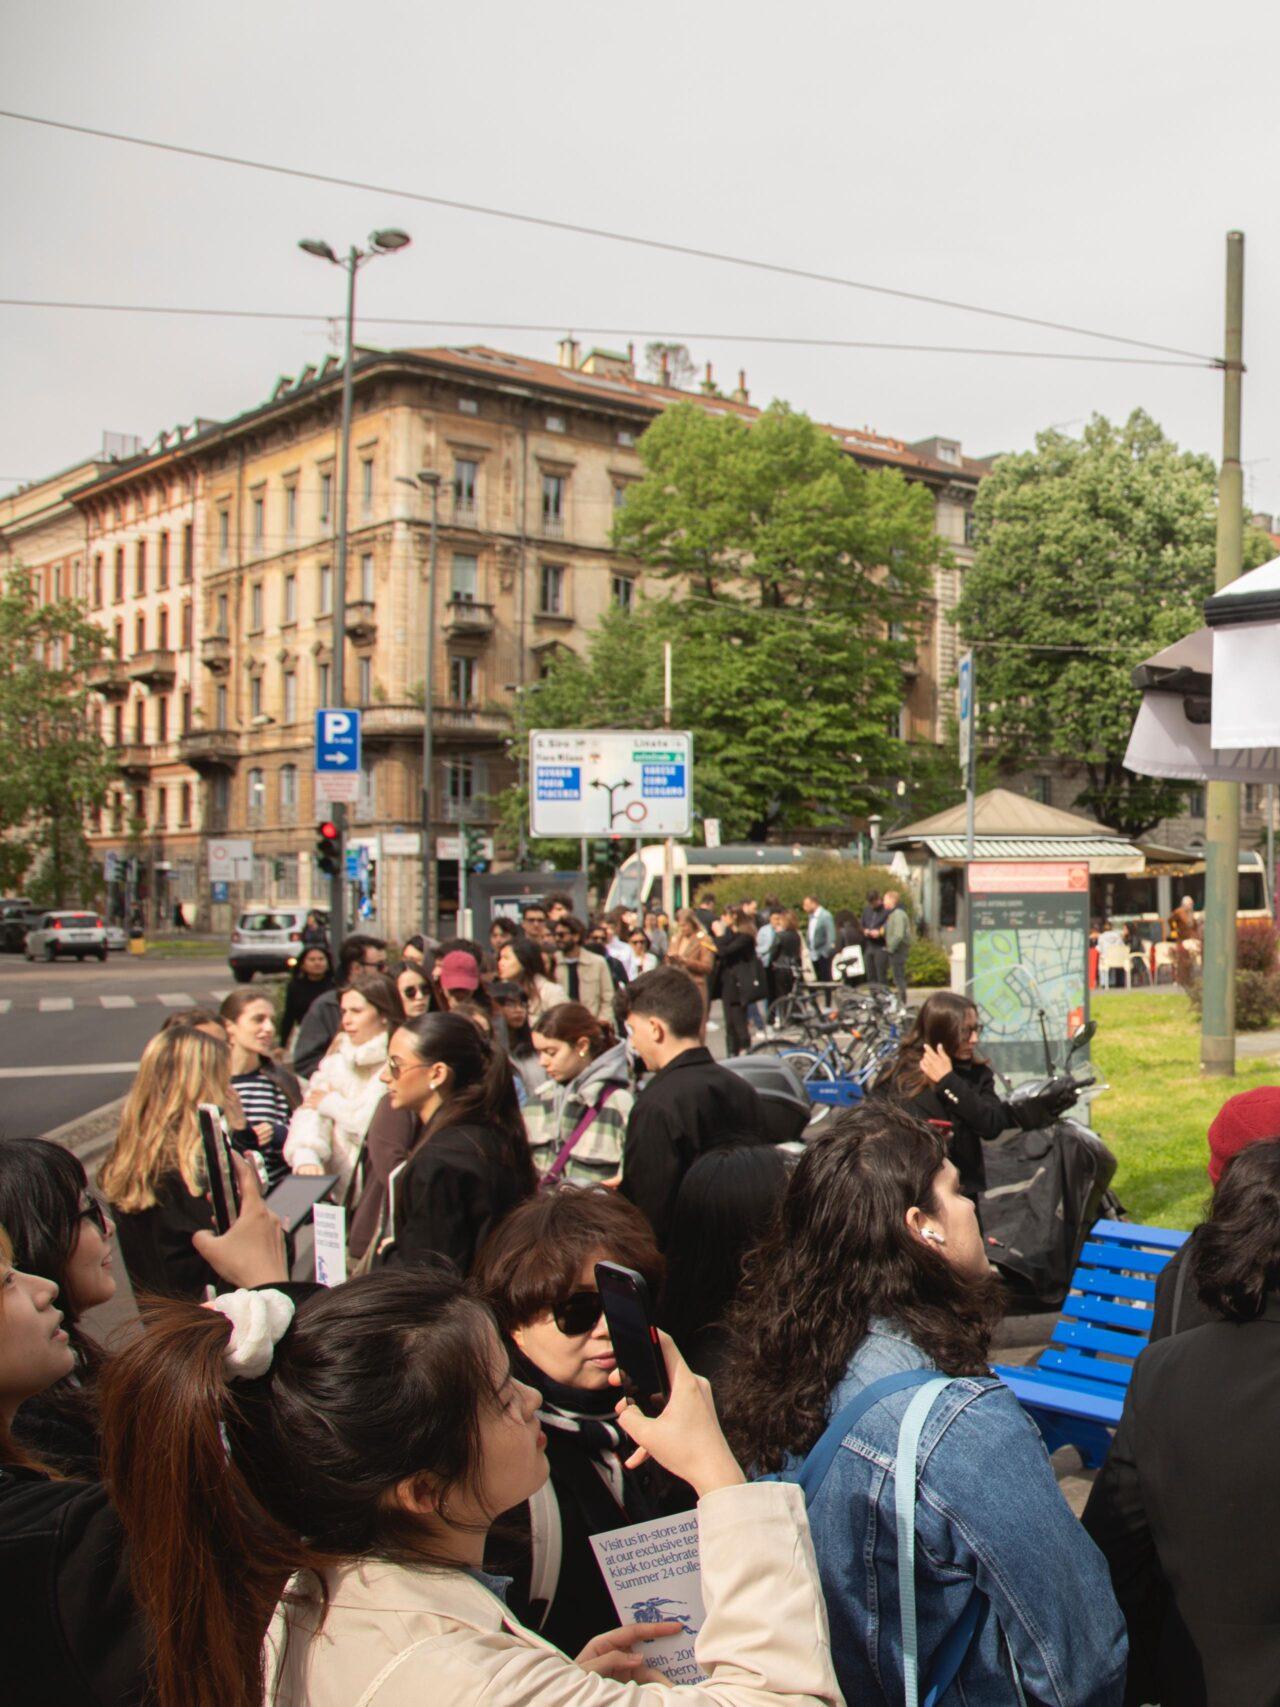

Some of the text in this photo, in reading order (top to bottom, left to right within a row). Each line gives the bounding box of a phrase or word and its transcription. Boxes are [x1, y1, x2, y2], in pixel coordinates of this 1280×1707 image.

[325, 713, 351, 744] P
[599, 1518, 698, 1552] Visit us in-store and
[605, 1555, 616, 1566] at
[616, 1552, 636, 1563] our
[635, 1539, 682, 1556] exclusive
[609, 1549, 698, 1578] kiosk to celebrate
[614, 1571, 660, 1590] Summer
[662, 1568, 675, 1580] 24
[646, 1654, 669, 1668] 18th
